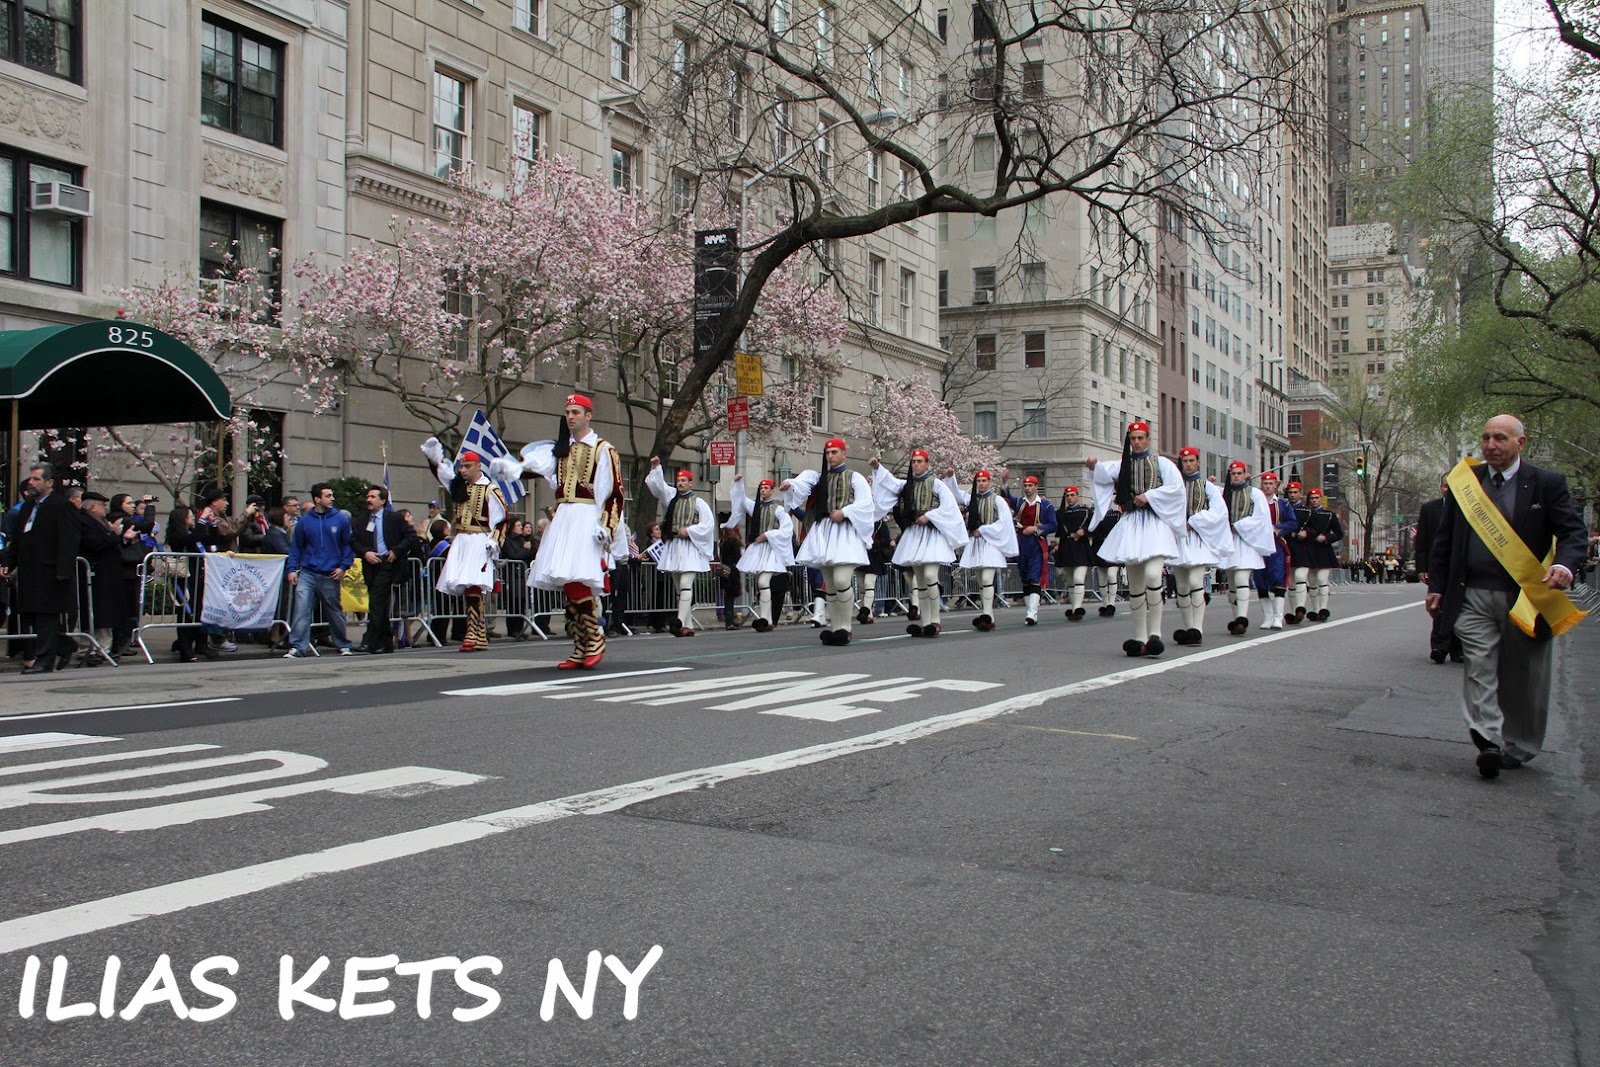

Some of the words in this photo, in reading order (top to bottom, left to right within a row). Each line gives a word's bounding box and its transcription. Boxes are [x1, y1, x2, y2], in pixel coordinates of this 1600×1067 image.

[108, 326, 153, 348] 825
[1472, 503, 1499, 536] COMMITTEE
[440, 667, 1004, 721] LANE
